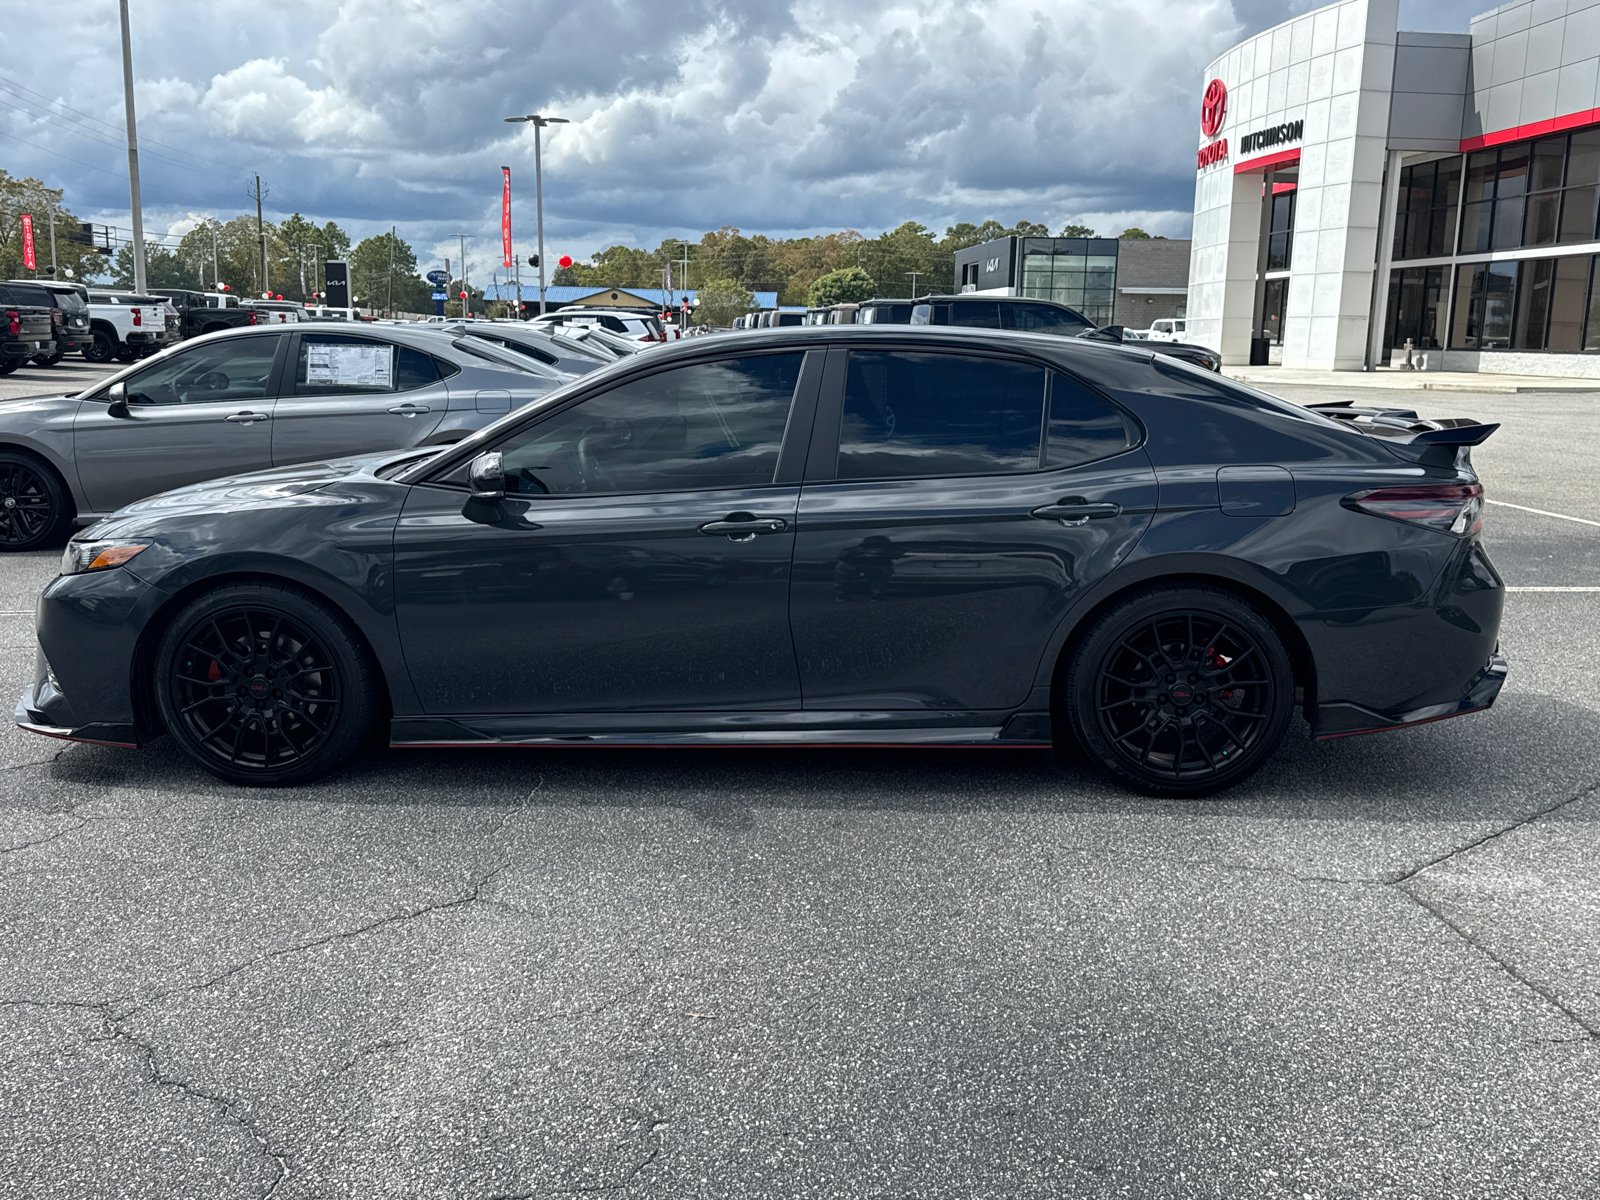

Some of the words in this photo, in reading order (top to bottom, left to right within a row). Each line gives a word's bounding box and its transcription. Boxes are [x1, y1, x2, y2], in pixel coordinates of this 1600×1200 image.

[1197, 138, 1228, 170] TOYOTA
[1240, 119, 1304, 154] HUTCHINSON
[26, 226, 34, 267] TOYOTA
